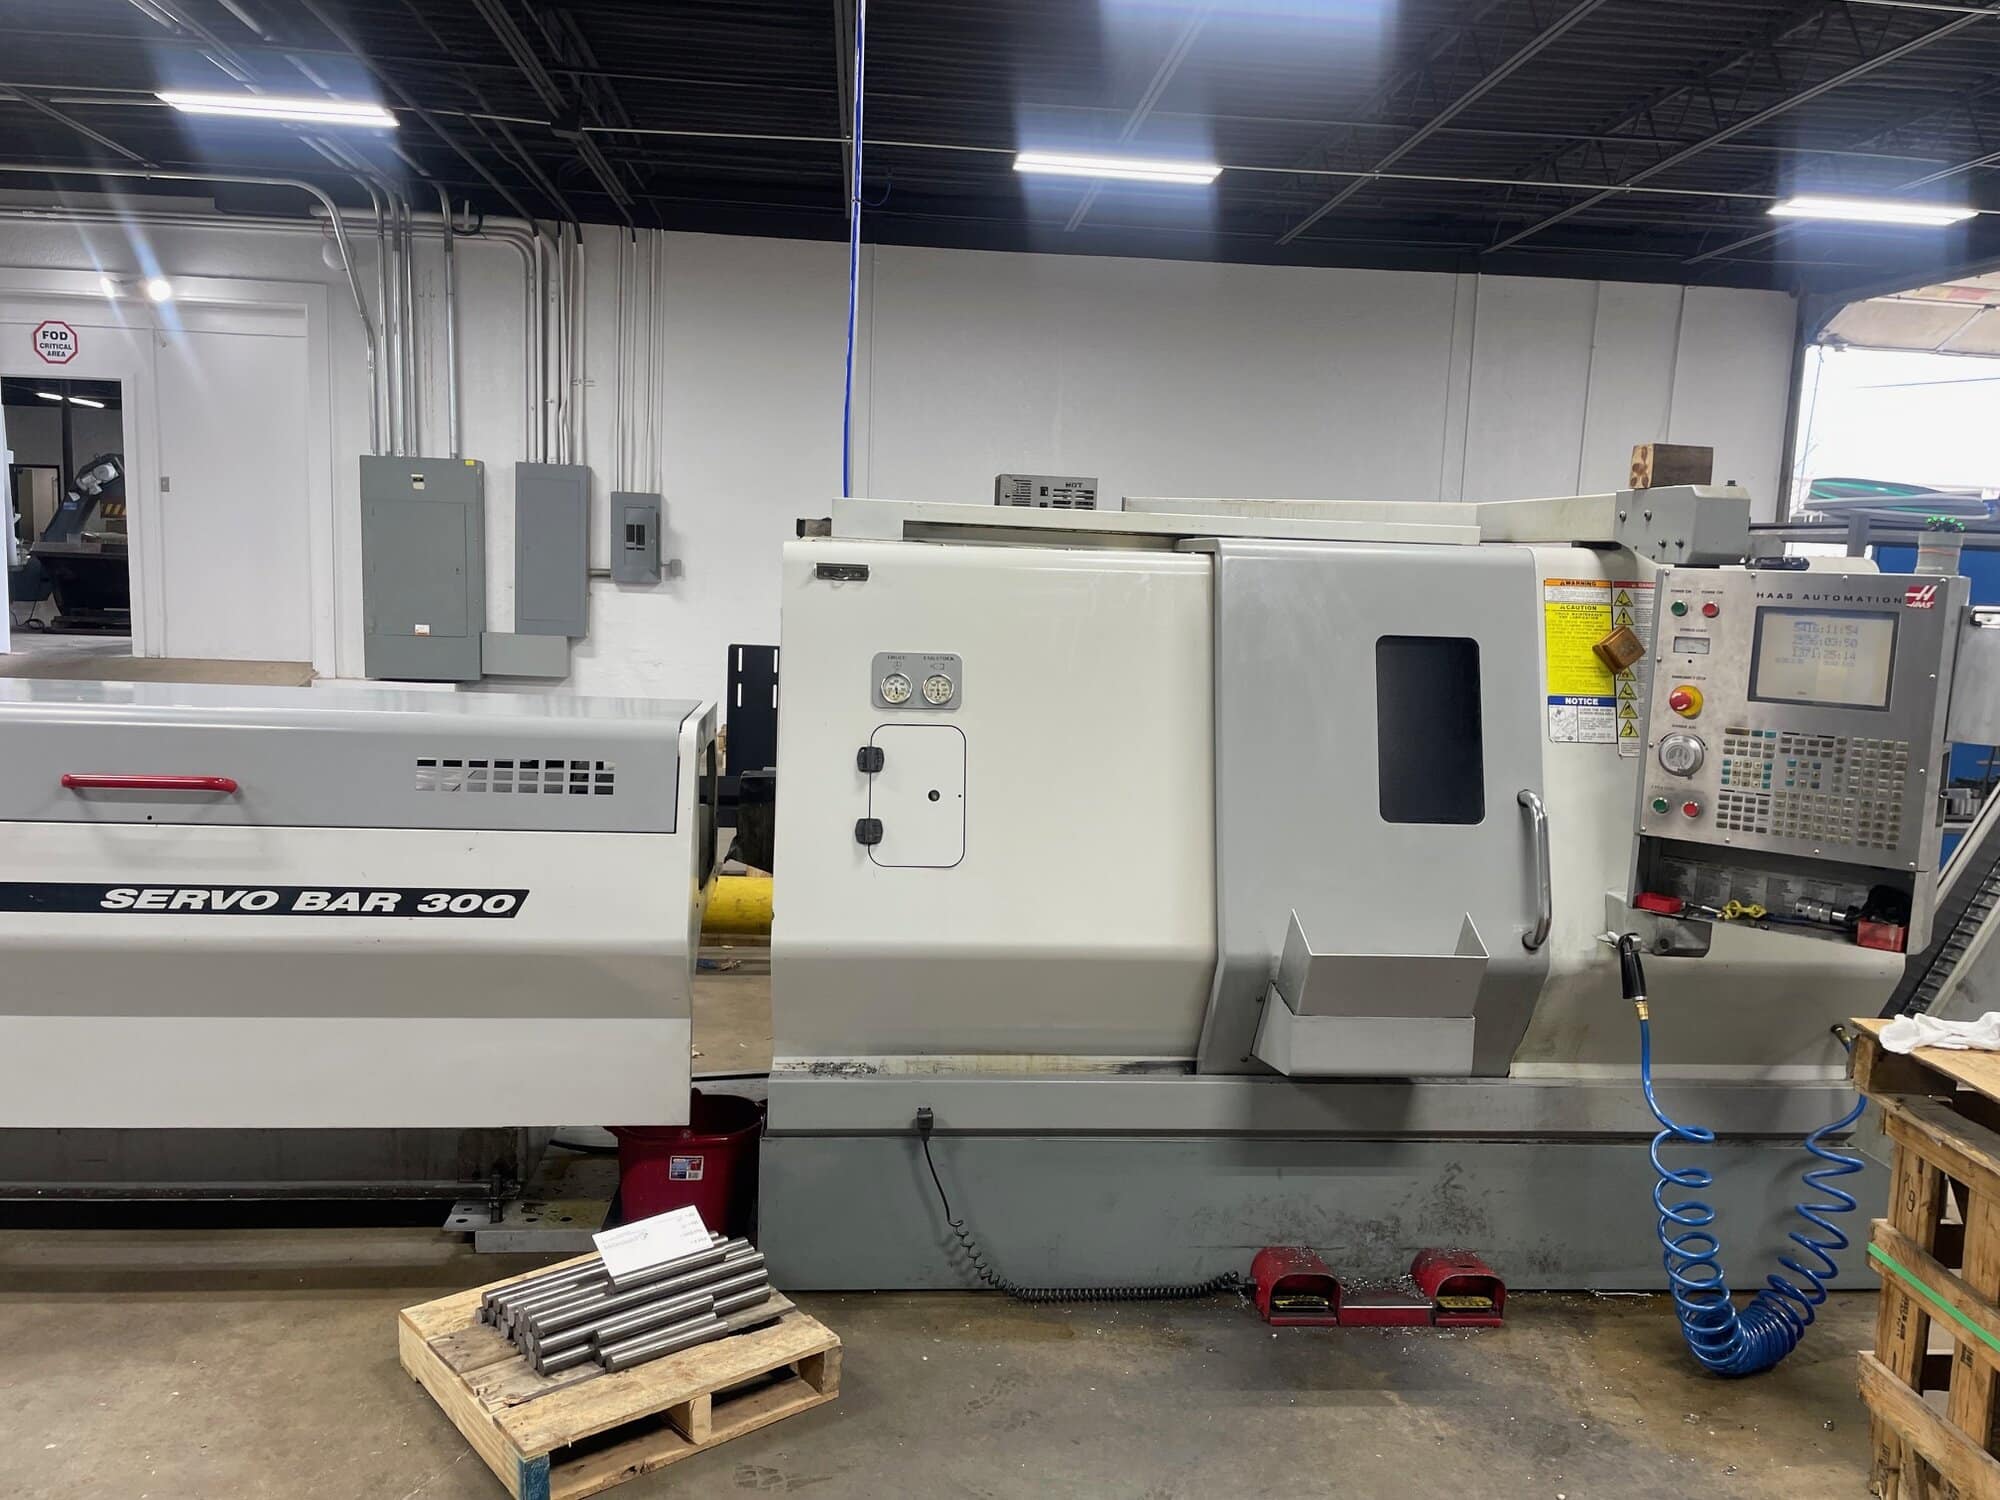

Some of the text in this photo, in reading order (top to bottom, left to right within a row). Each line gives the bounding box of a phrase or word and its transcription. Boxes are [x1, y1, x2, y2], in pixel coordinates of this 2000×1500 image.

[42, 330, 68, 340] FOD
[39, 342, 72, 350] CRITICAL
[1756, 592, 1904, 604] HAAS AUTOMATION
[1564, 697, 1599, 706] NOTICE
[100, 888, 516, 914] SERVO BAR 300
